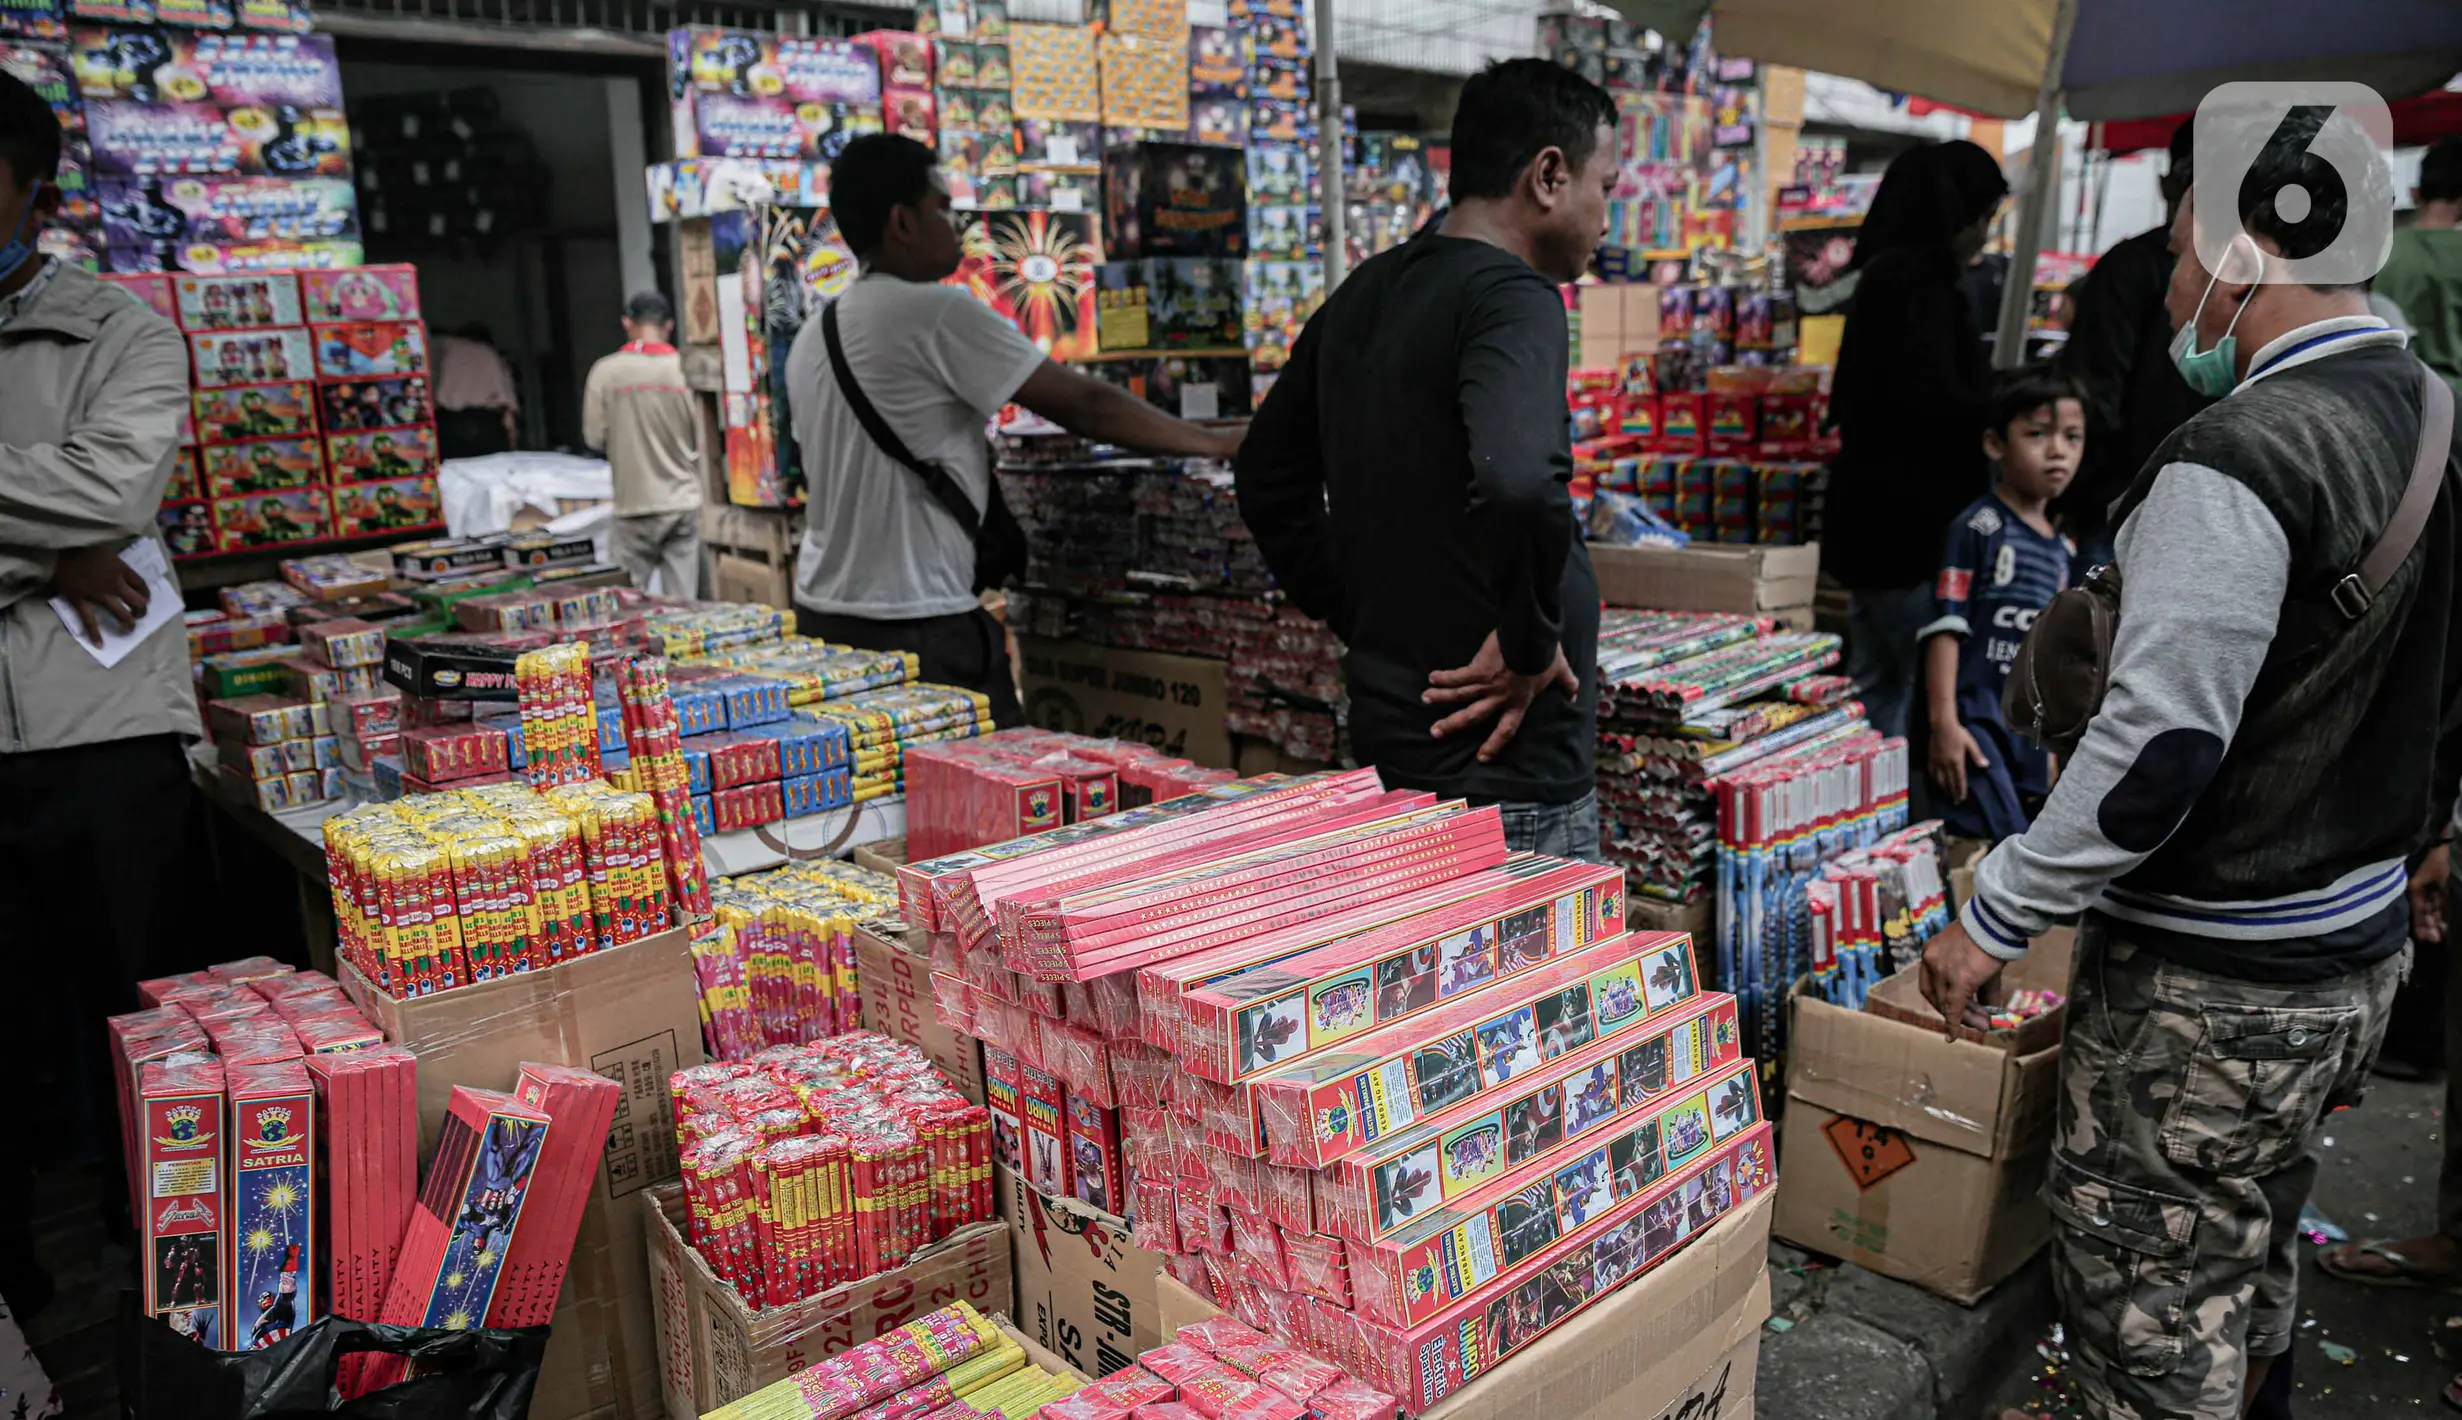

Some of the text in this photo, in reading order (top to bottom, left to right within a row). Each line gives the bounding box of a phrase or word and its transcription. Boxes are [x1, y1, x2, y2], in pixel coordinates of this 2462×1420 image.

[1993, 544, 2016, 587] 9
[465, 671, 505, 688] HAPPY
[1170, 680, 1201, 708] 120
[1026, 1095, 1058, 1134] JUMBO
[1372, 1072, 1388, 1132] KEMBANG API
[243, 1153, 304, 1169] SATRIA
[1862, 1145, 1875, 1160] G
[1456, 1227, 1472, 1287] KEMBANG API
[678, 1311, 694, 1400] HOOKS
[1431, 1333, 1448, 1398] Electric
[1459, 1315, 1484, 1381] JUMBO
[1403, 1350, 1411, 1392] PIECES
[1419, 1342, 1434, 1406] Sparklers
